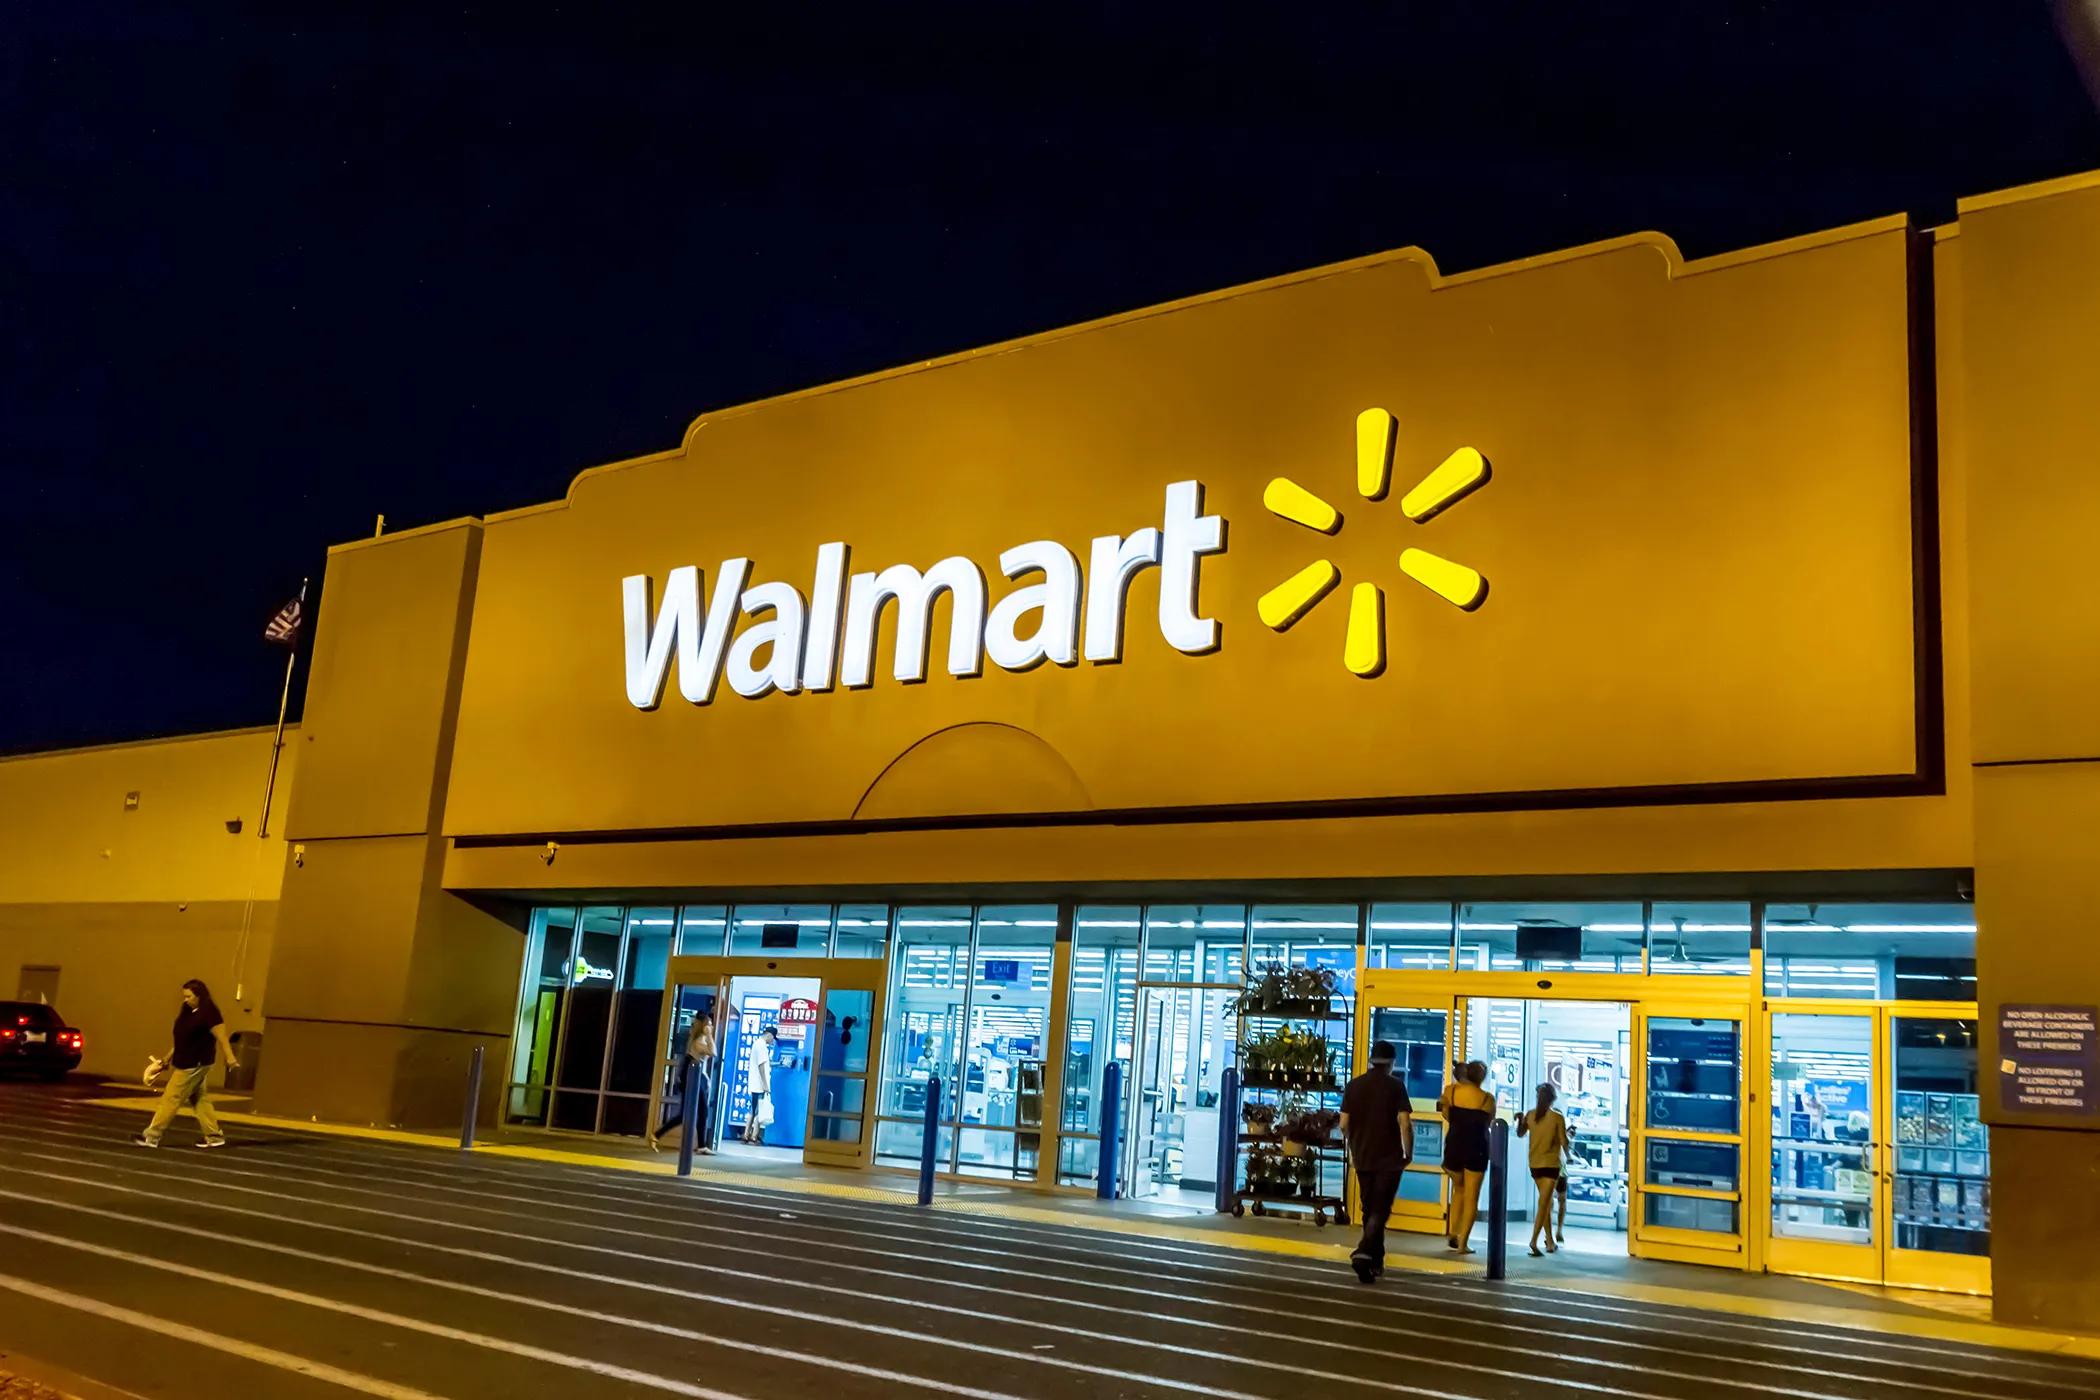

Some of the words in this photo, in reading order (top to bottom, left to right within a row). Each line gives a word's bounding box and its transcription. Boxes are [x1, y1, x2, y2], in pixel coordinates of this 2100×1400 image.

[622, 479, 1226, 710] Walmart
[2006, 1011, 2020, 1020] NO
[2021, 1011, 2043, 1020] OPEN
[2044, 1012, 2090, 1021] ALCOHOLIC
[2002, 1020, 2043, 1029] BEVERAGE
[2044, 1021, 2095, 1031] CONTAINERS
[2013, 1030, 2029, 1039] ARE
[2030, 1031, 2070, 1040] ALLOWED
[2070, 1032, 2084, 1040] ON
[2017, 1041, 2041, 1050] THESE
[2042, 1042, 2081, 1051] PREMISES
[2018, 1066, 2031, 1075] NO
[2032, 1067, 2074, 1077] LOITERING
[2074, 1069, 2083, 1077] IS
[2017, 1076, 2057, 1086] ALLOWED
[2057, 1078, 2071, 1086] ON
[2071, 1078, 2084, 1087] OR
[2025, 1086, 2035, 1094] IN
[2035, 1086, 2062, 1096] FRONT
[2063, 1087, 2075, 1096] OF
[2019, 1095, 2043, 1105] THESE
[2044, 1097, 2084, 1107] PREMISES
